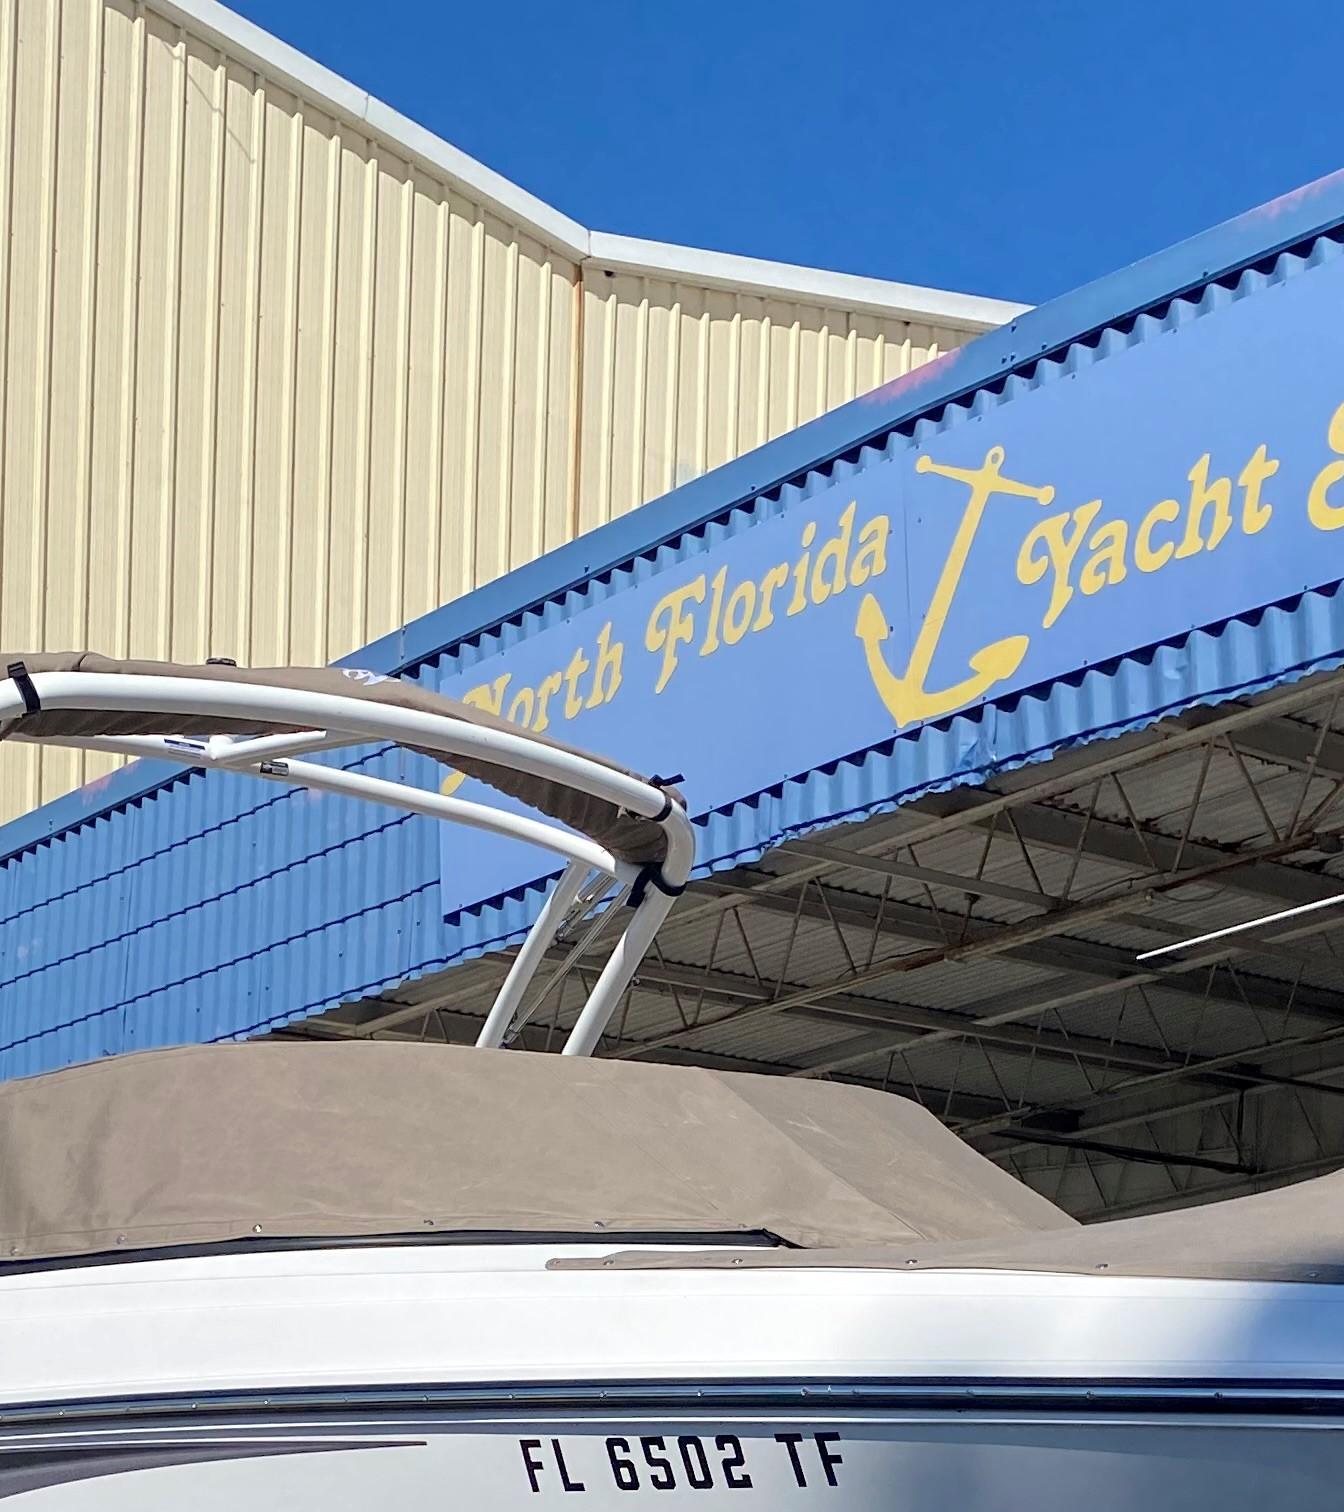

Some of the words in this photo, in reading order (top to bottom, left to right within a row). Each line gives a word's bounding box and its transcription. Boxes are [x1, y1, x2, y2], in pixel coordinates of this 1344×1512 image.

[644, 500, 891, 695] Florida
[1016, 444, 1280, 630] Yacht
[519, 1438, 586, 1493] FL
[605, 1433, 754, 1491] 6502
[774, 1431, 844, 1488] TF
